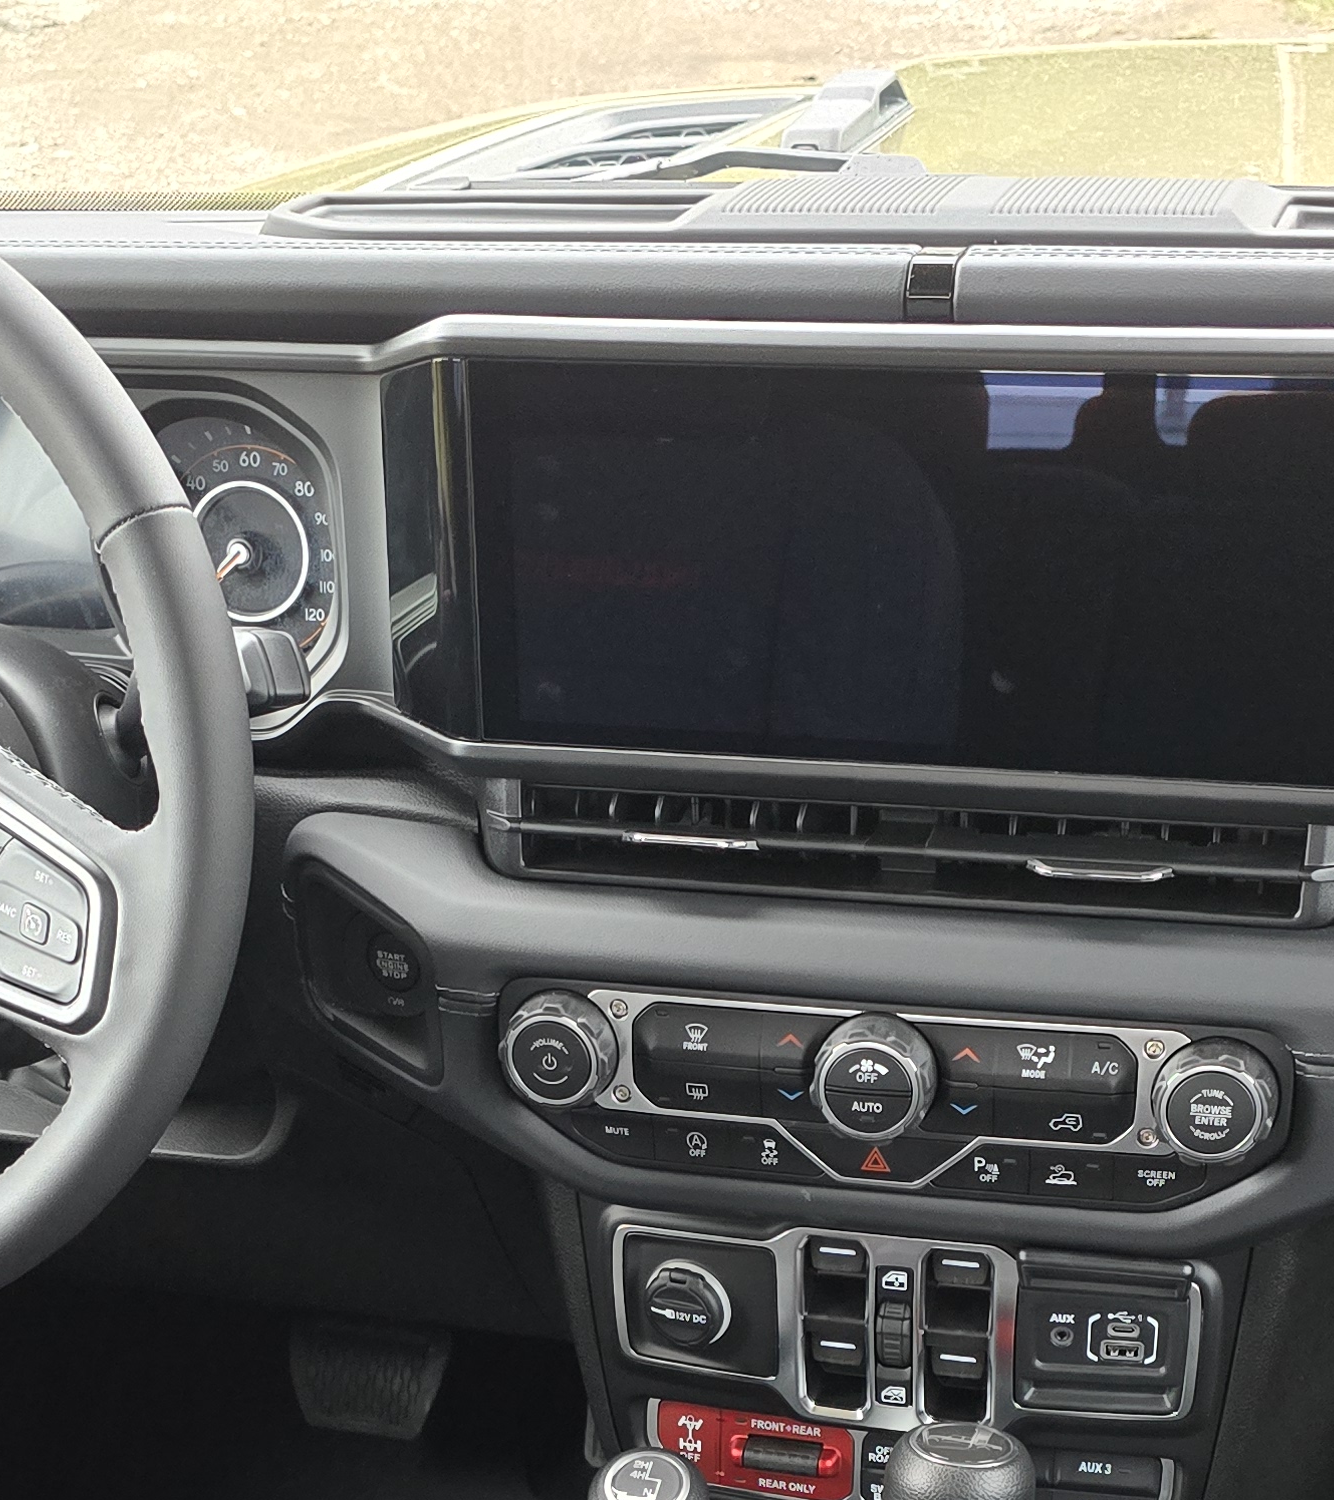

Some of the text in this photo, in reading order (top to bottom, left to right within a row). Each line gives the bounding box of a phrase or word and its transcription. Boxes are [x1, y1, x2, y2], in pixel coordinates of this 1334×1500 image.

[239, 451, 261, 468] 60
[213, 460, 229, 473] 50
[272, 462, 288, 476] 70
[187, 475, 206, 491] 40
[294, 481, 314, 497] 80
[320, 549, 335, 562] 10
[319, 581, 335, 594] 110
[305, 608, 325, 622] 120
[56, 929, 72, 944] RES
[376, 950, 406, 961] START
[382, 969, 408, 980] STOP
[534, 1038, 564, 1049] VOLUME
[682, 1041, 709, 1052] FRONT
[1021, 1069, 1046, 1080] MODE
[1091, 1061, 1119, 1076] A/C
[856, 1072, 879, 1084] OFF
[1202, 1089, 1225, 1100] TUNE
[851, 1101, 883, 1114] AUTO
[1190, 1103, 1233, 1115] BROWSE
[1194, 1116, 1227, 1126] ENTER
[605, 1126, 630, 1136] MUTE
[1193, 1129, 1226, 1141] SCROLL
[689, 1149, 706, 1158] OFF
[761, 1157, 779, 1166] OFF
[979, 1173, 999, 1183] OFF
[1137, 1170, 1176, 1180] SCREEN
[1146, 1179, 1166, 1188] OFF
[676, 1311, 707, 1324] 12V DC
[1049, 1313, 1075, 1324] AUX
[1078, 1461, 1112, 1475] AUX 3
[630, 1471, 646, 1480] 4H
[643, 1488, 652, 1496] N
[758, 1478, 816, 1494] REAR ONLY
